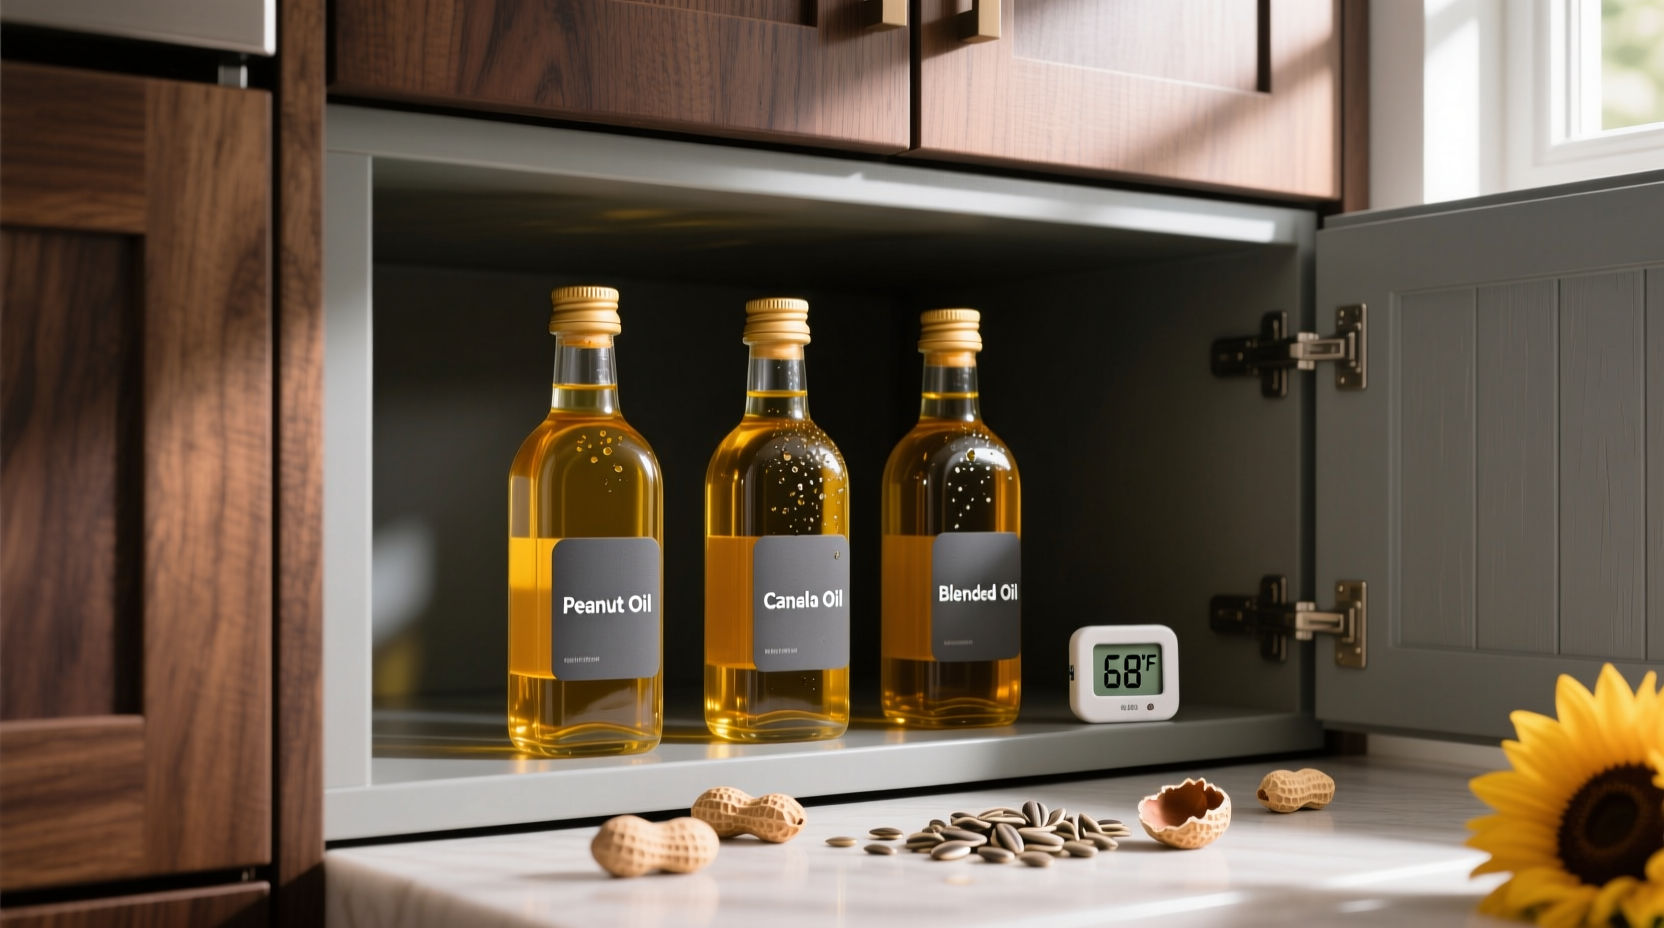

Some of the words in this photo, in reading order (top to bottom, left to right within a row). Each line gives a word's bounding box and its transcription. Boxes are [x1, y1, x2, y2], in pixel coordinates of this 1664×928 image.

[822, 589, 843, 608] Oil
[939, 584, 997, 602] Blended
[1000, 583, 1018, 601] Oil
[563, 597, 625, 615] Peanut
[628, 593, 652, 613] Oil
